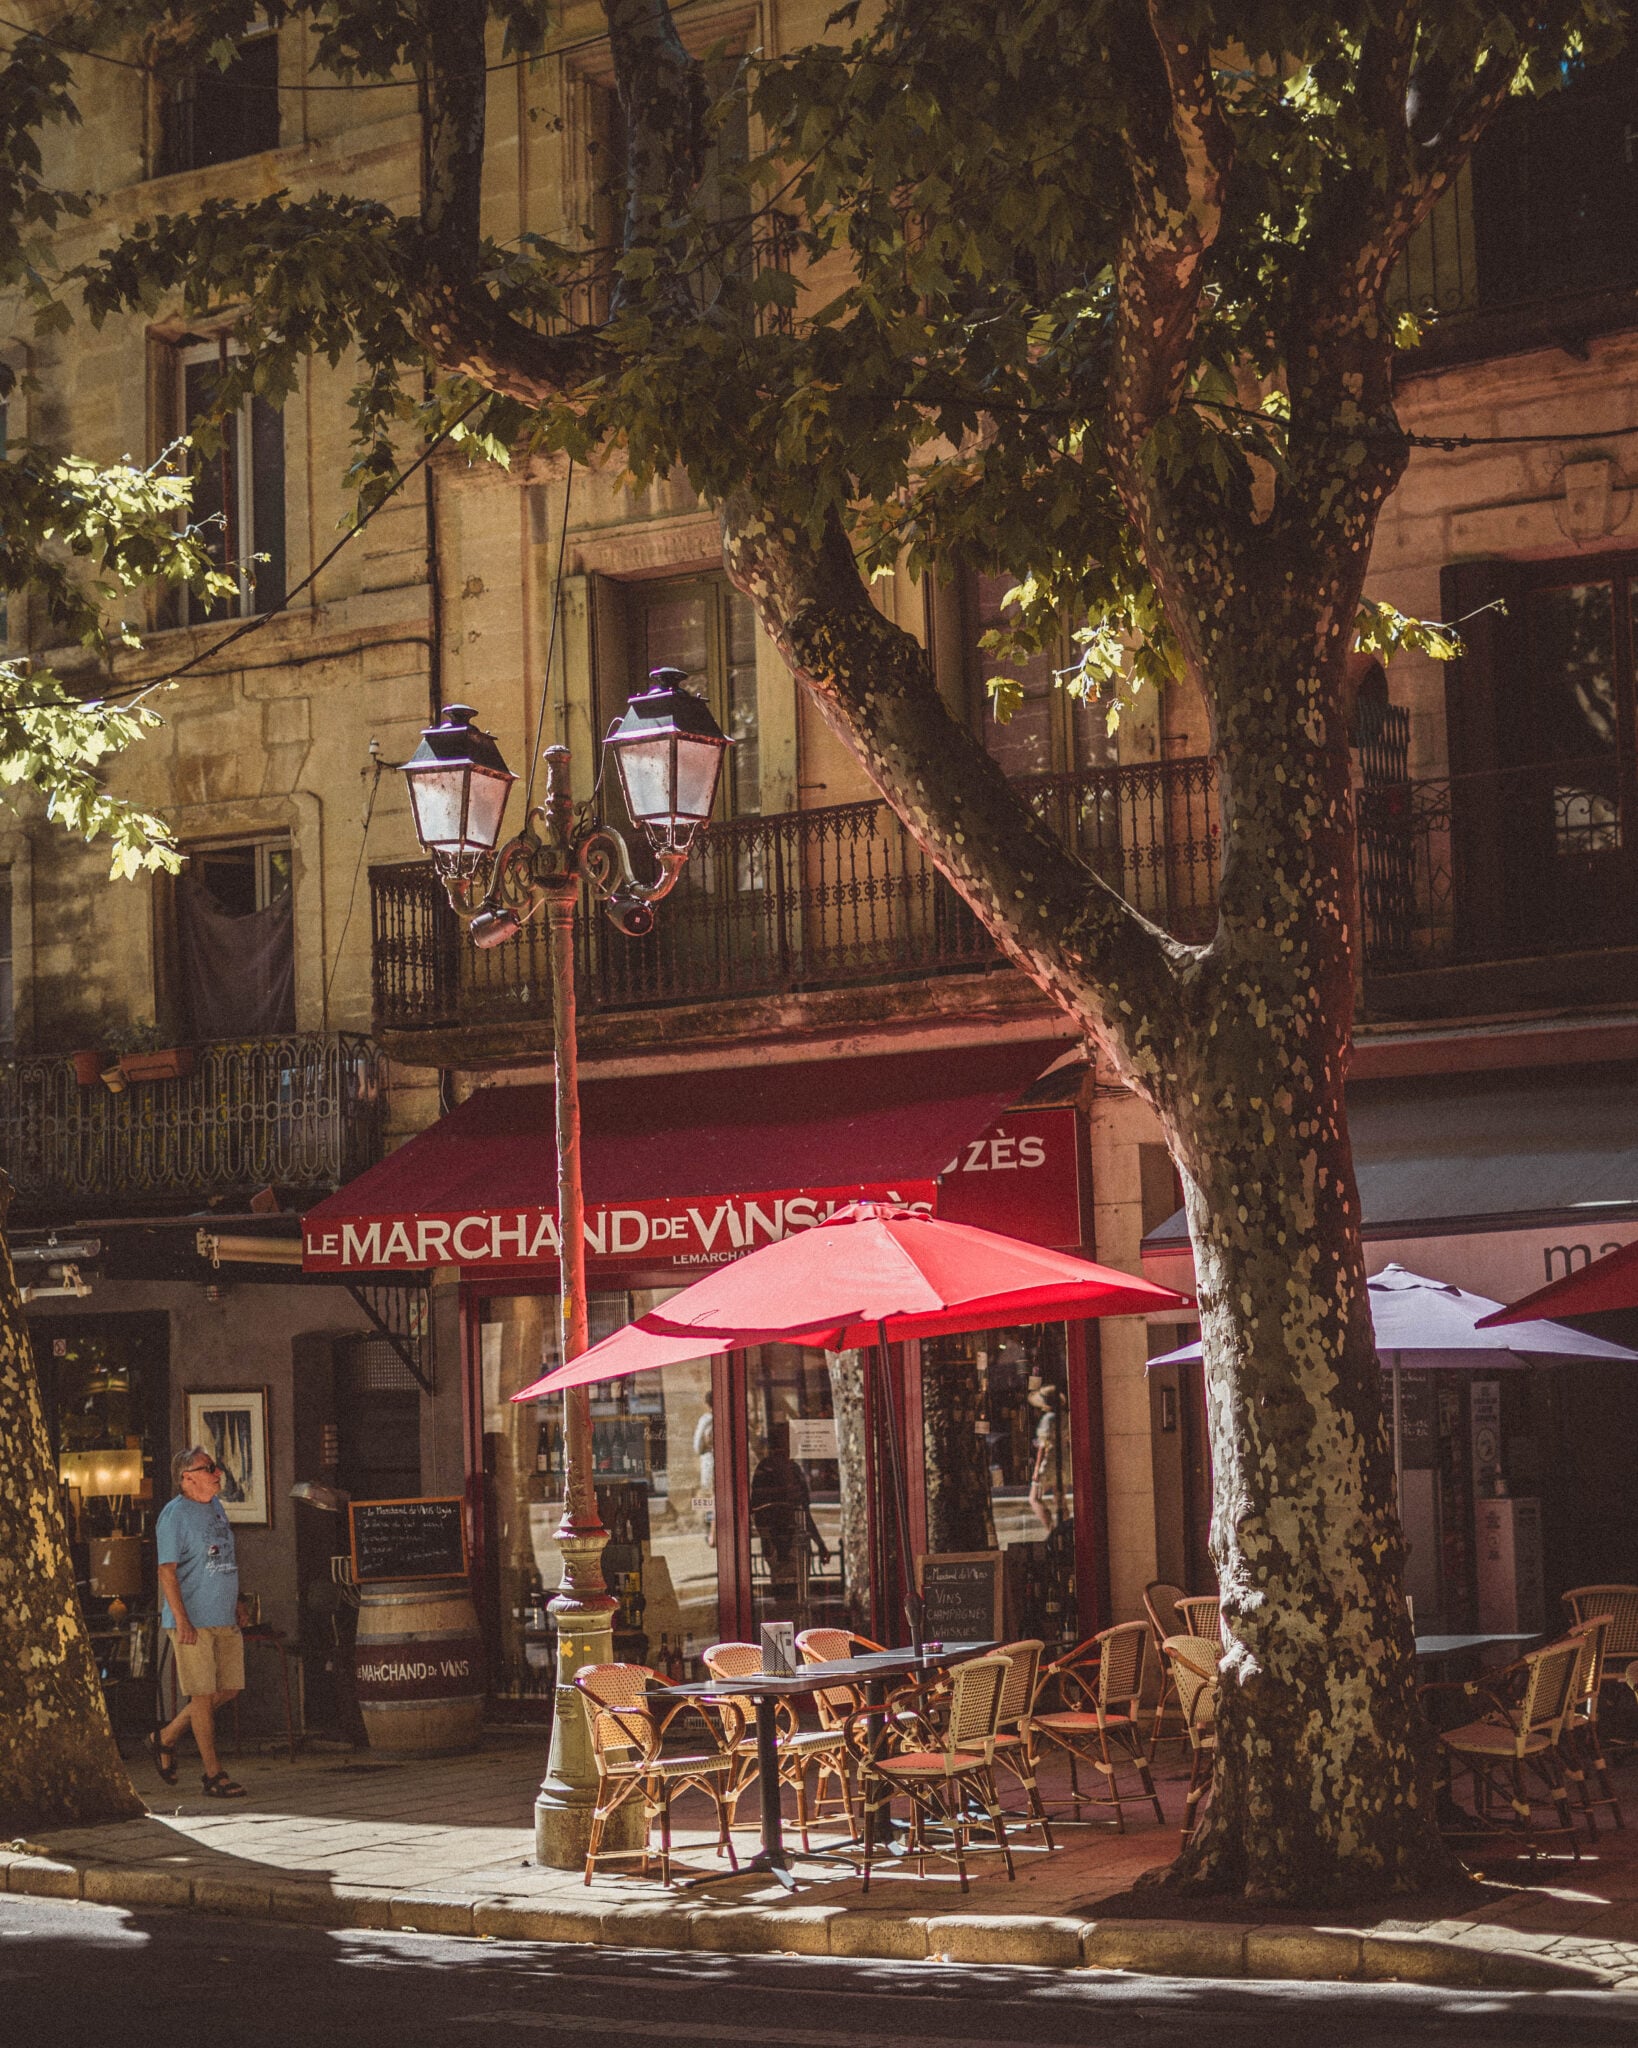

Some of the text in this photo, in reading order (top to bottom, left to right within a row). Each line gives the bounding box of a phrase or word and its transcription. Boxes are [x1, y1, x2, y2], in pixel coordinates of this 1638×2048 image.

[941, 1129, 1046, 1174] ZÈS
[307, 1233, 339, 1256] LE
[341, 1210, 649, 1265] MARCHAND
[652, 1216, 689, 1241] DE
[361, 1663, 427, 1681] MARCHAND
